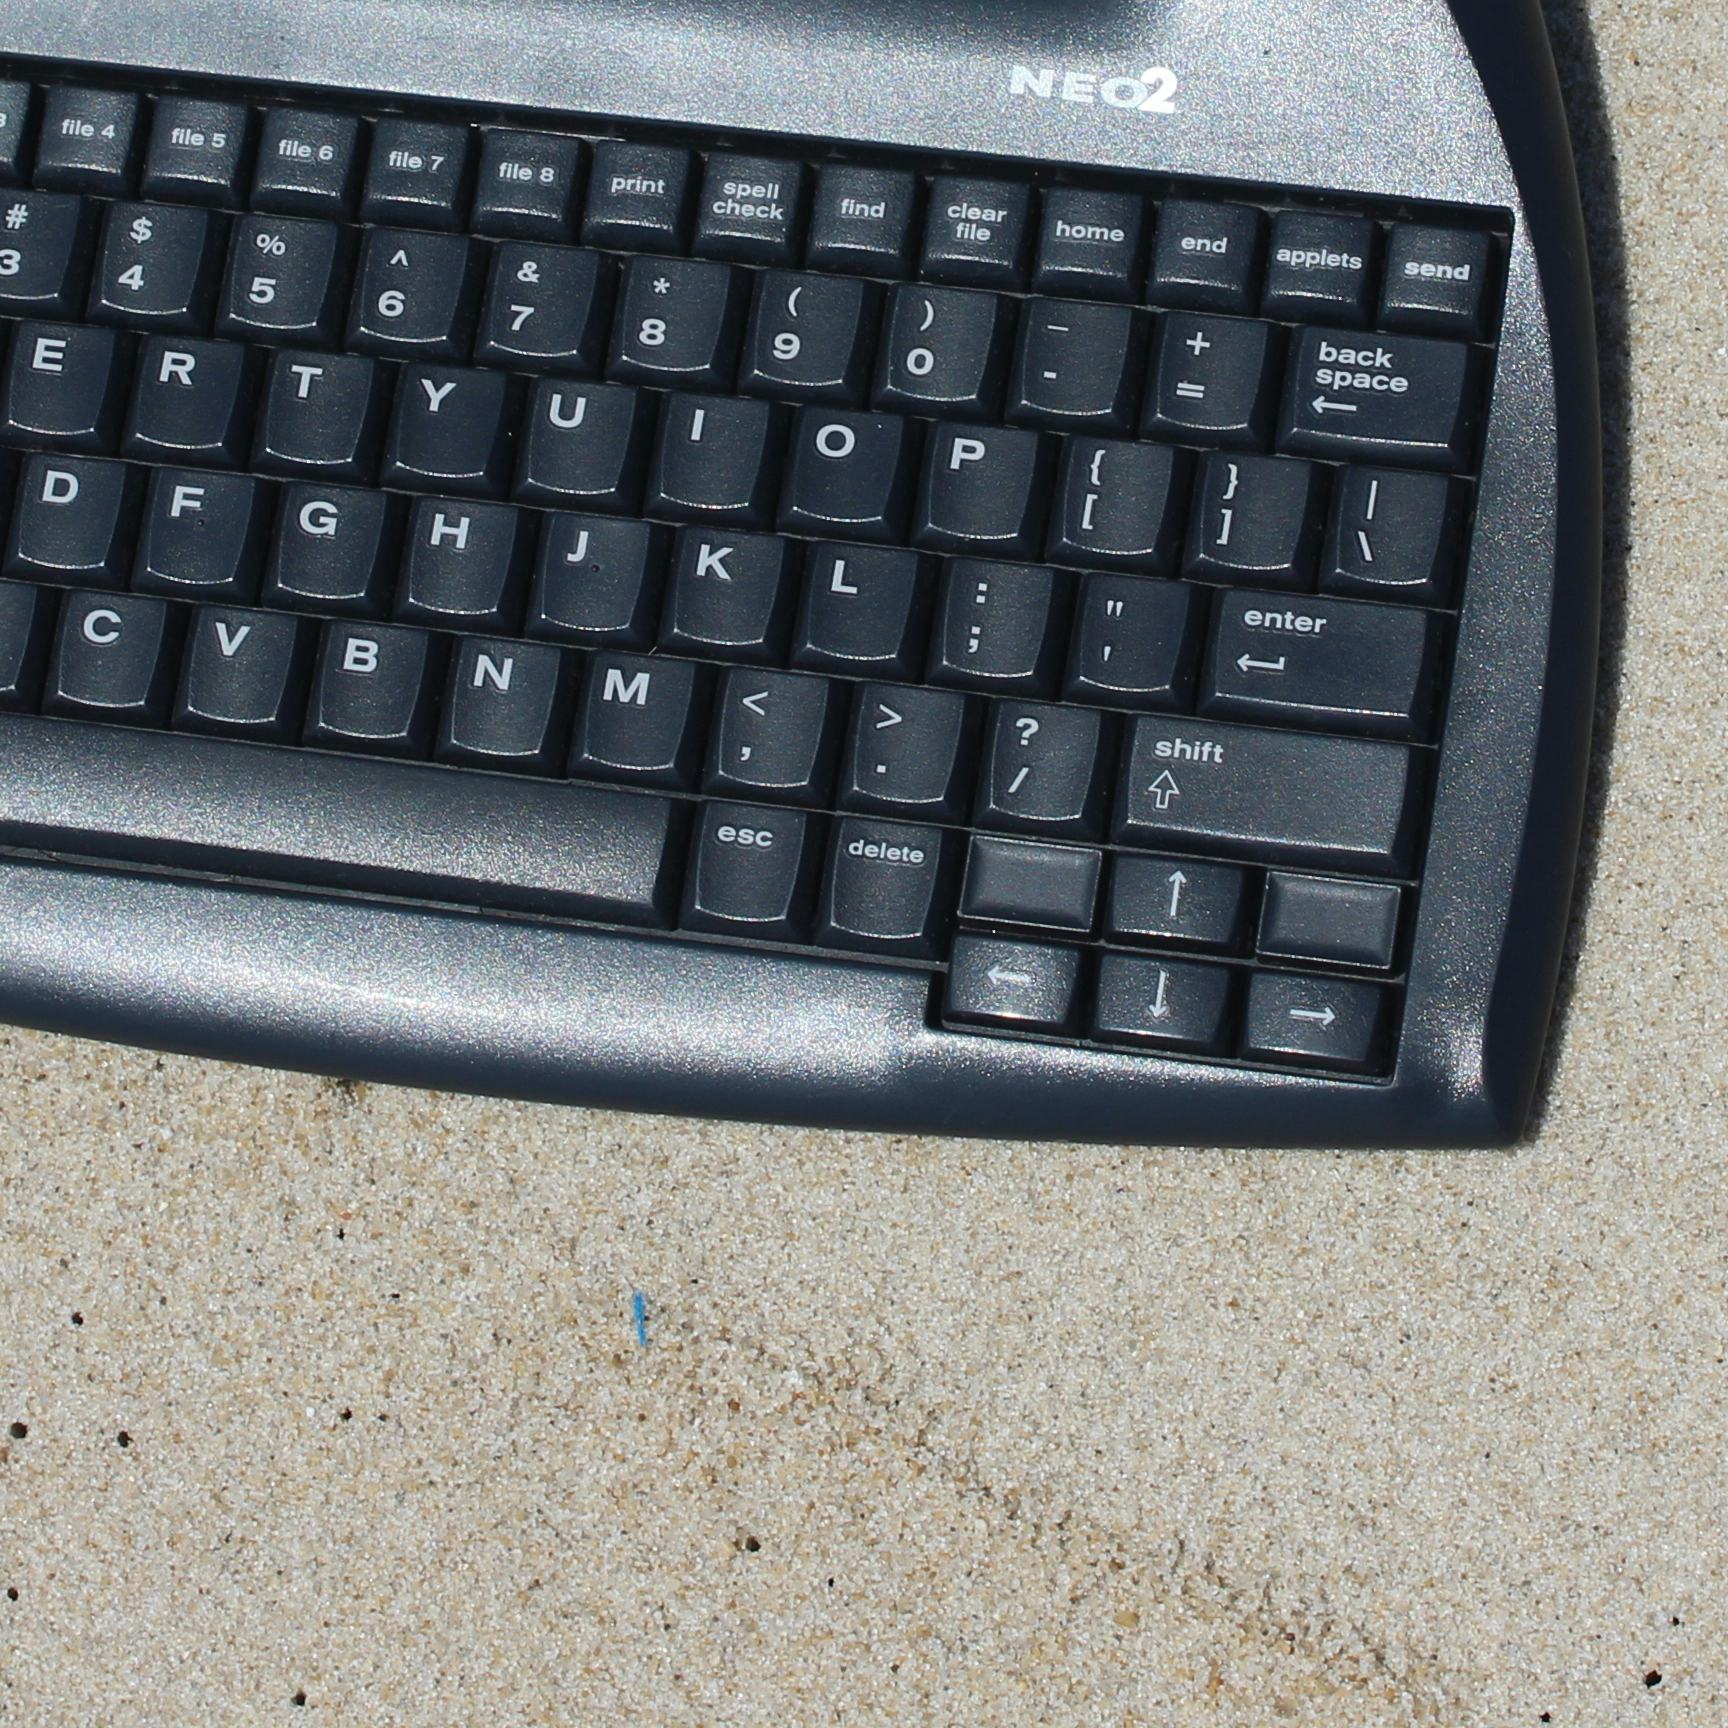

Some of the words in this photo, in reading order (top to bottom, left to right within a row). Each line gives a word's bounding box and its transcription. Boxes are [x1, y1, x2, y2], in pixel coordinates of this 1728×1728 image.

[1010, 65, 1178, 113] NEO2
[61, 118, 95, 138] file
[101, 124, 115, 139] 4
[171, 127, 205, 146] file
[211, 132, 226, 149] 5
[278, 139, 312, 158] file
[318, 145, 334, 161] 6
[389, 150, 423, 169] file
[430, 155, 445, 171] 7
[499, 162, 533, 181] file
[539, 167, 555, 183] 8
[610, 175, 665, 194] print
[723, 180, 780, 202] spell
[712, 198, 783, 220] check
[841, 198, 886, 218] find
[947, 202, 1007, 223] clear
[956, 222, 991, 241] file
[1055, 220, 1125, 242] home
[1180, 236, 1228, 254] end
[1276, 248, 1362, 270] applets
[1404, 261, 1470, 281] send
[118, 264, 144, 291] 4
[249, 276, 277, 304] 5
[378, 290, 406, 317] 6
[510, 304, 535, 331] 7
[639, 318, 666, 346] 8
[772, 332, 801, 360] 9
[32, 337, 67, 372] E
[159, 351, 196, 385] R
[906, 347, 934, 376] 0
[1319, 342, 1393, 368] back
[291, 364, 323, 398] T
[1315, 366, 1409, 393] space
[421, 378, 457, 412] Y
[549, 393, 587, 428] U
[690, 409, 705, 441] I
[816, 424, 856, 458] O
[950, 437, 986, 470] P
[42, 470, 79, 504] D
[170, 485, 205, 517] F
[299, 501, 338, 536] G
[430, 513, 470, 549] H
[566, 530, 589, 562] J
[696, 544, 734, 581] K
[831, 559, 858, 594] L
[83, 609, 122, 644] C
[1244, 610, 1327, 633] enter
[215, 622, 251, 656] V
[343, 637, 379, 673] B
[473, 654, 514, 691] N
[603, 668, 650, 706] M
[1154, 738, 1224, 764] shift
[717, 826, 773, 847] esc
[848, 839, 924, 863] delete
